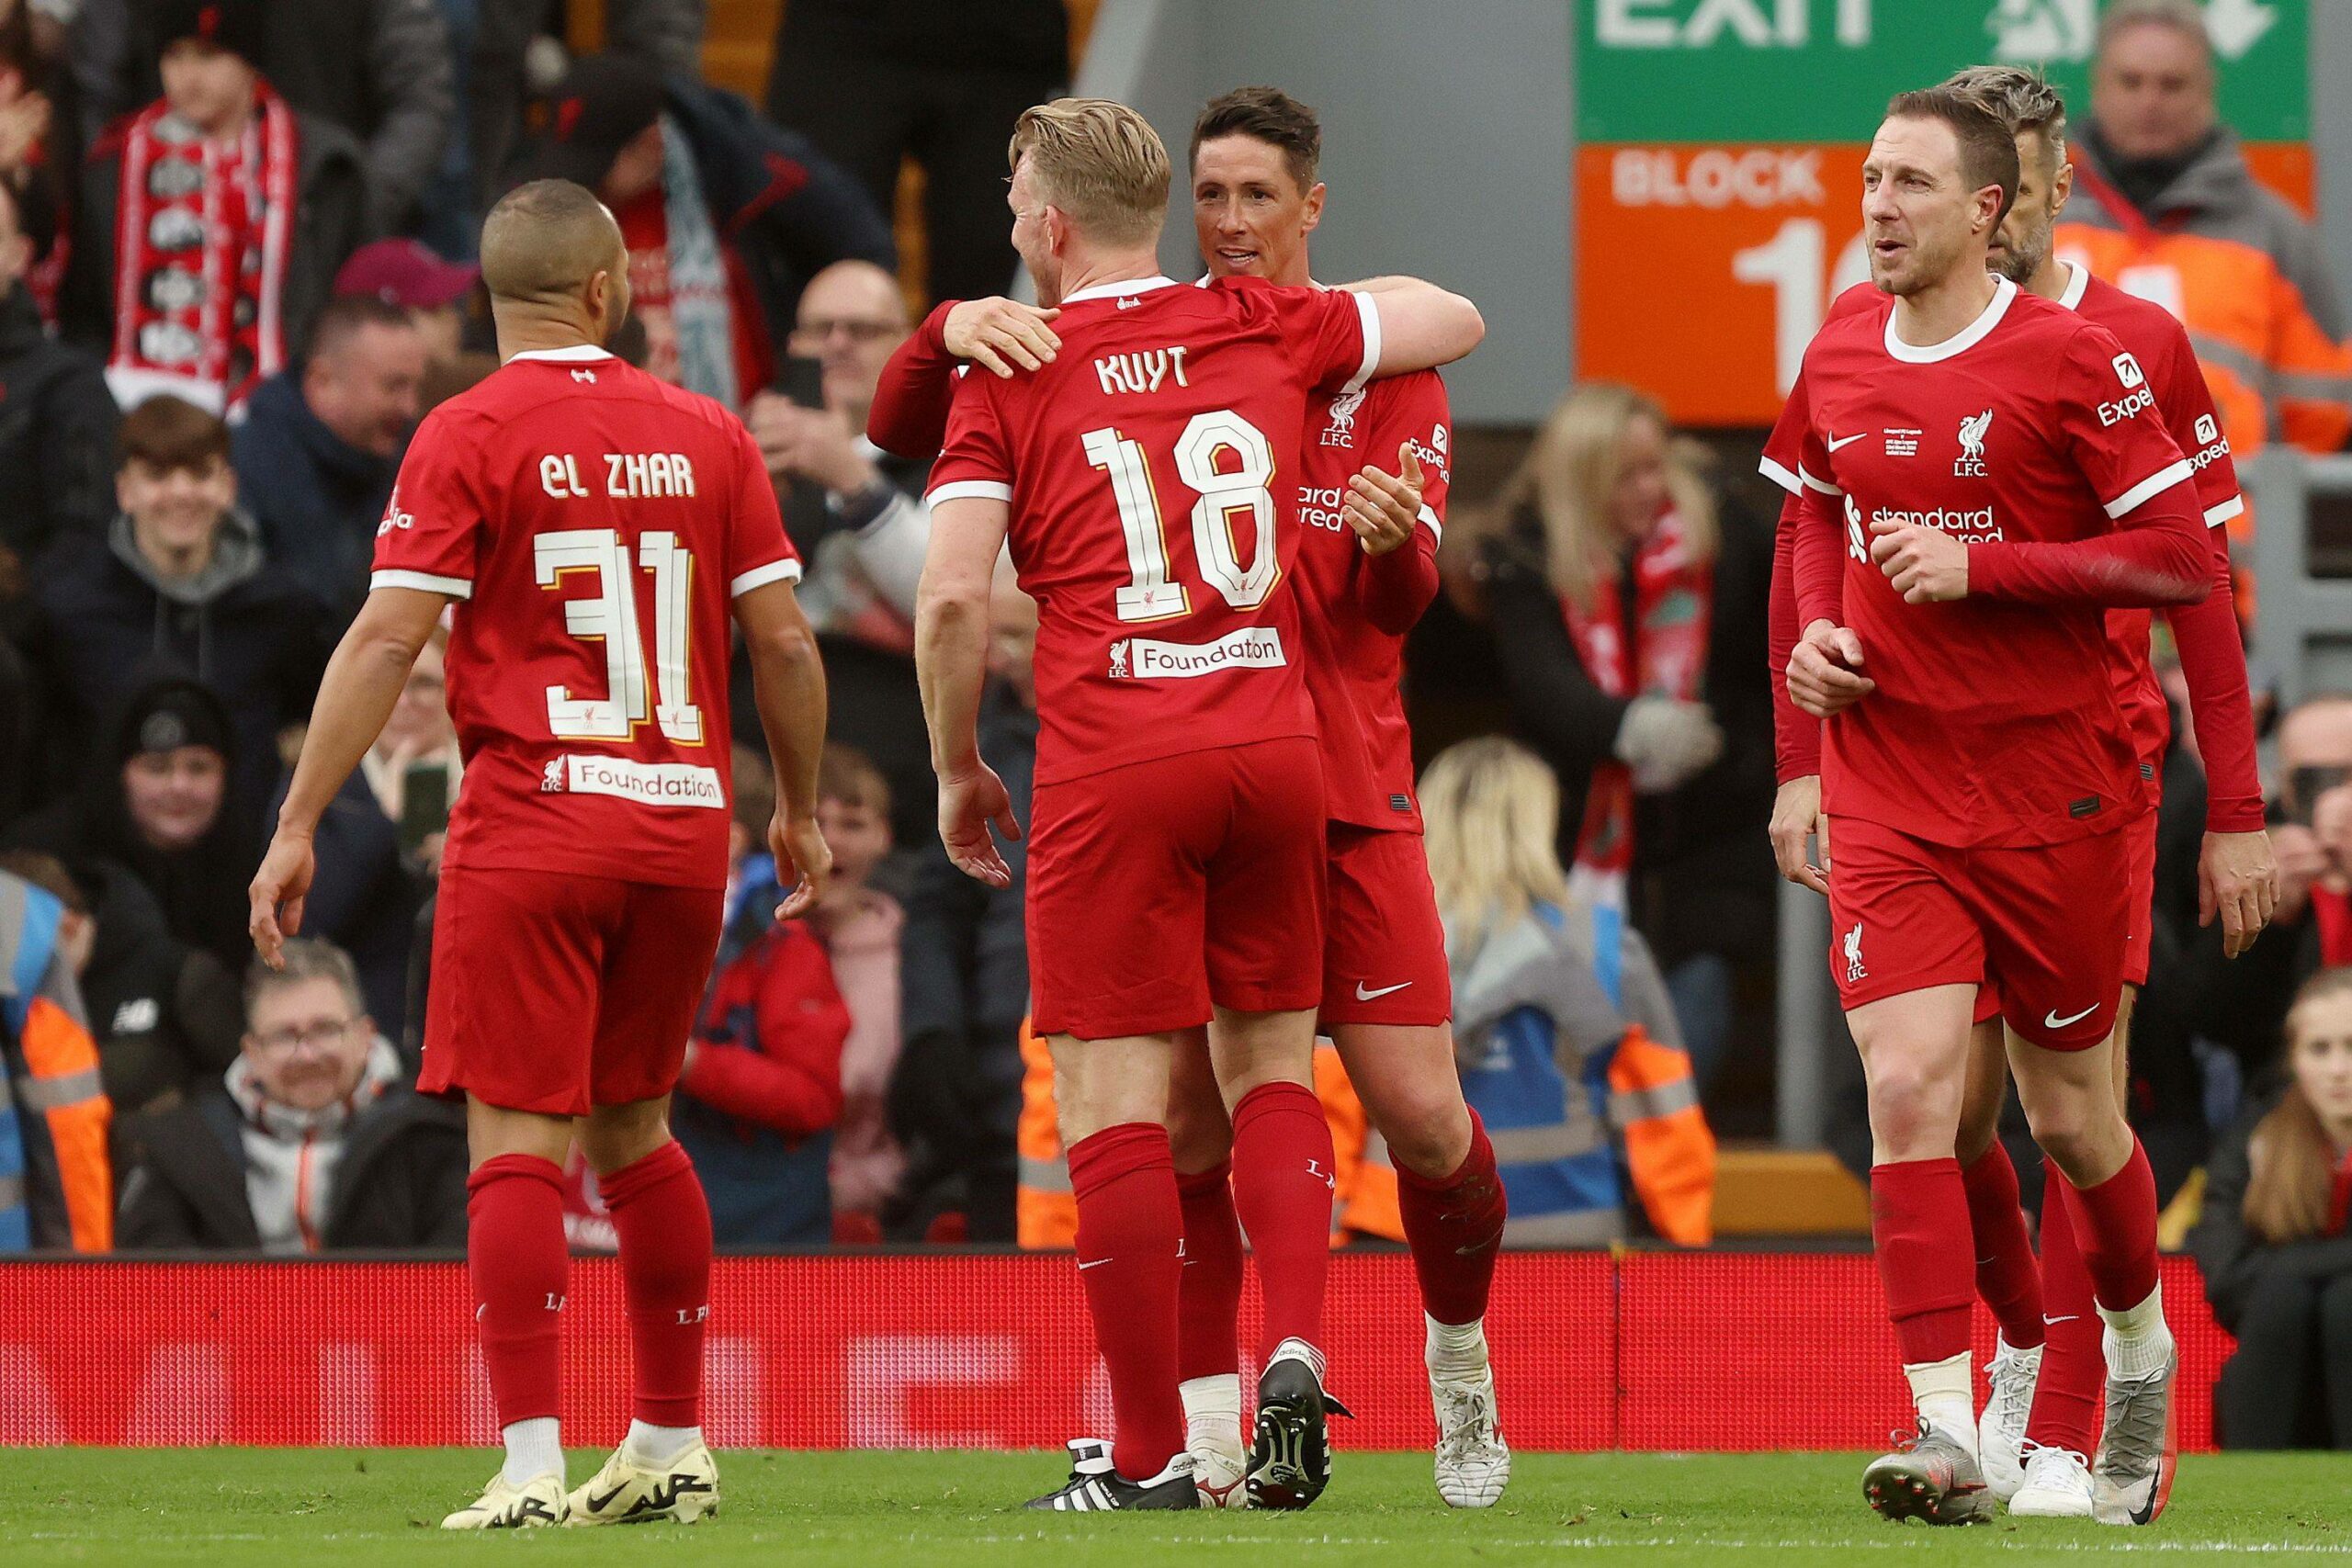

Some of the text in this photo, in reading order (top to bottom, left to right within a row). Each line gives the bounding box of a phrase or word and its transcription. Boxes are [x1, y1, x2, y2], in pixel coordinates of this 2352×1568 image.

[1611, 149, 1826, 209] BLOCK
[1094, 345, 1189, 395] KUYT
[2097, 381, 2154, 427] Expe
[2188, 435, 2231, 469] xped
[603, 454, 695, 497] ZHAR
[1080, 410, 1283, 623] 18
[1297, 507, 1343, 532] red
[534, 529, 706, 748] 31
[1143, 639, 1277, 670] Foundation
[581, 764, 718, 800] Foundation
